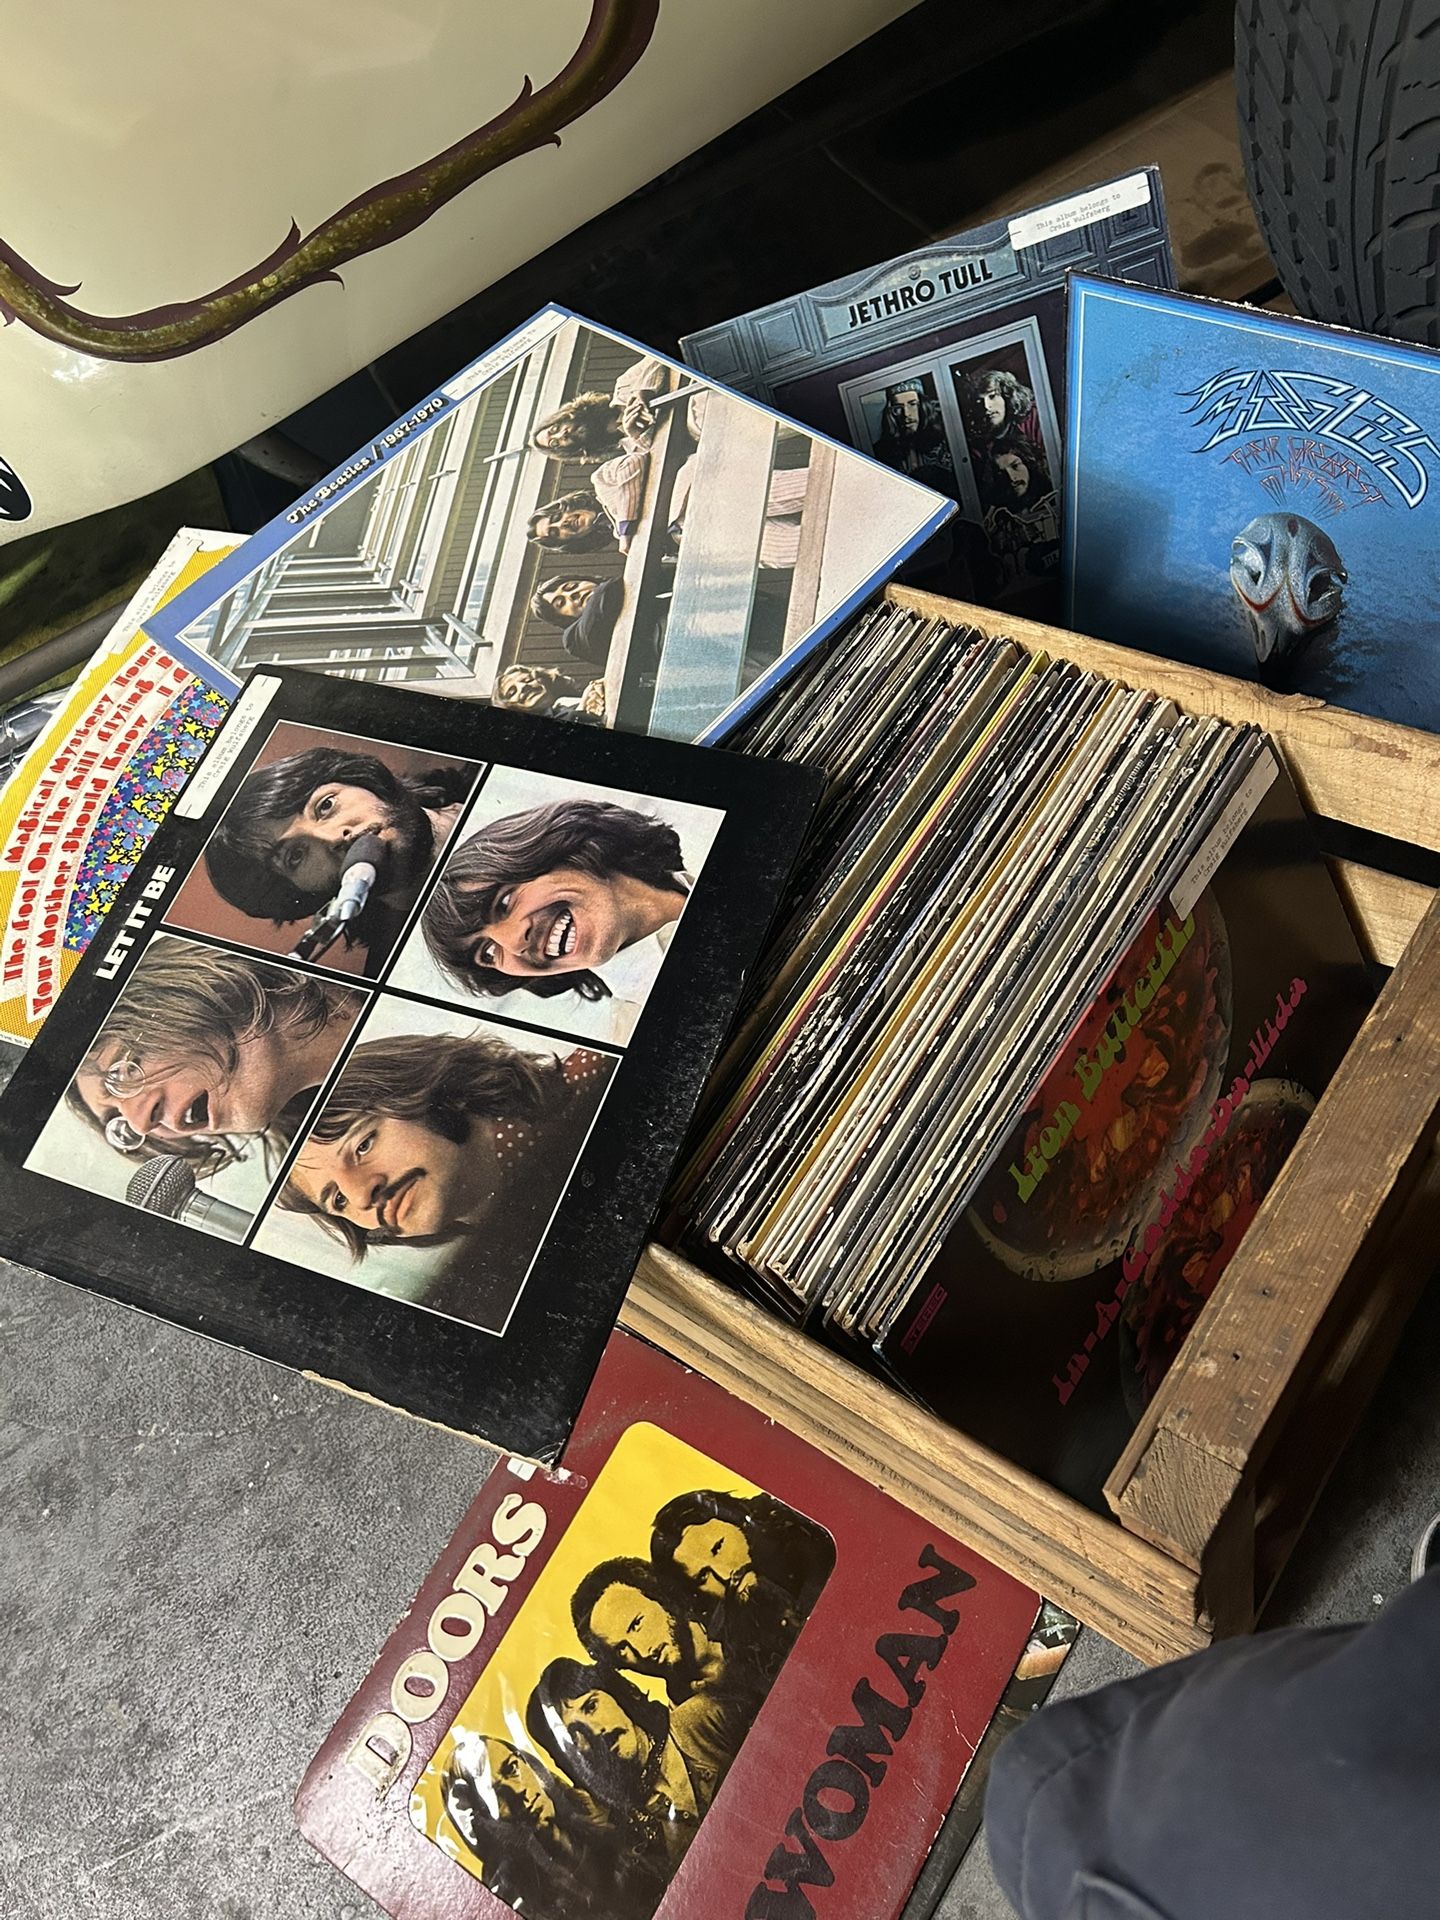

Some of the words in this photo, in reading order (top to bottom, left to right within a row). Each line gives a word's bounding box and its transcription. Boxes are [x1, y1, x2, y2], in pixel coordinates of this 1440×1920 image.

[1036, 220, 1053, 228] This
[1054, 211, 1077, 221] album
[1079, 199, 1109, 212] belongs
[1112, 192, 1120, 200] to
[1049, 221, 1070, 231] Craig
[1072, 206, 1111, 221] Wulfsberg
[848, 280, 935, 328] JETHRO
[939, 259, 992, 295] TULL
[287, 498, 317, 523] The
[319, 458, 371, 500] Beatles
[381, 397, 444, 447] 1967-1970
[1174, 367, 1440, 509] EAGLES
[4, 780, 57, 863] Magical
[50, 694, 114, 773] Mystery
[112, 645, 157, 687] Tour
[100, 714, 148, 771] Know
[198, 771, 211, 788] This
[210, 746, 226, 768] album
[226, 714, 245, 743] belongs
[245, 702, 253, 711] to
[39, 796, 73, 837] The
[61, 778, 108, 853] Should
[1191, 865, 1205, 883] This
[1204, 837, 1222, 860] album
[1222, 802, 1244, 833] belongs
[1244, 788, 1252, 797] to
[28, 842, 53, 873] On
[1202, 852, 1220, 876] Craig
[36, 860, 72, 948] Mother
[95, 930, 135, 980] LET
[125, 900, 152, 929] IT
[141, 865, 176, 900] BE
[3, 938, 27, 985] The
[32, 955, 53, 1016] Your
[1008, 1101, 1082, 1204] Iron
[345, 1493, 547, 1806] DOORS
[744, 1543, 977, 1920] WOMAN
